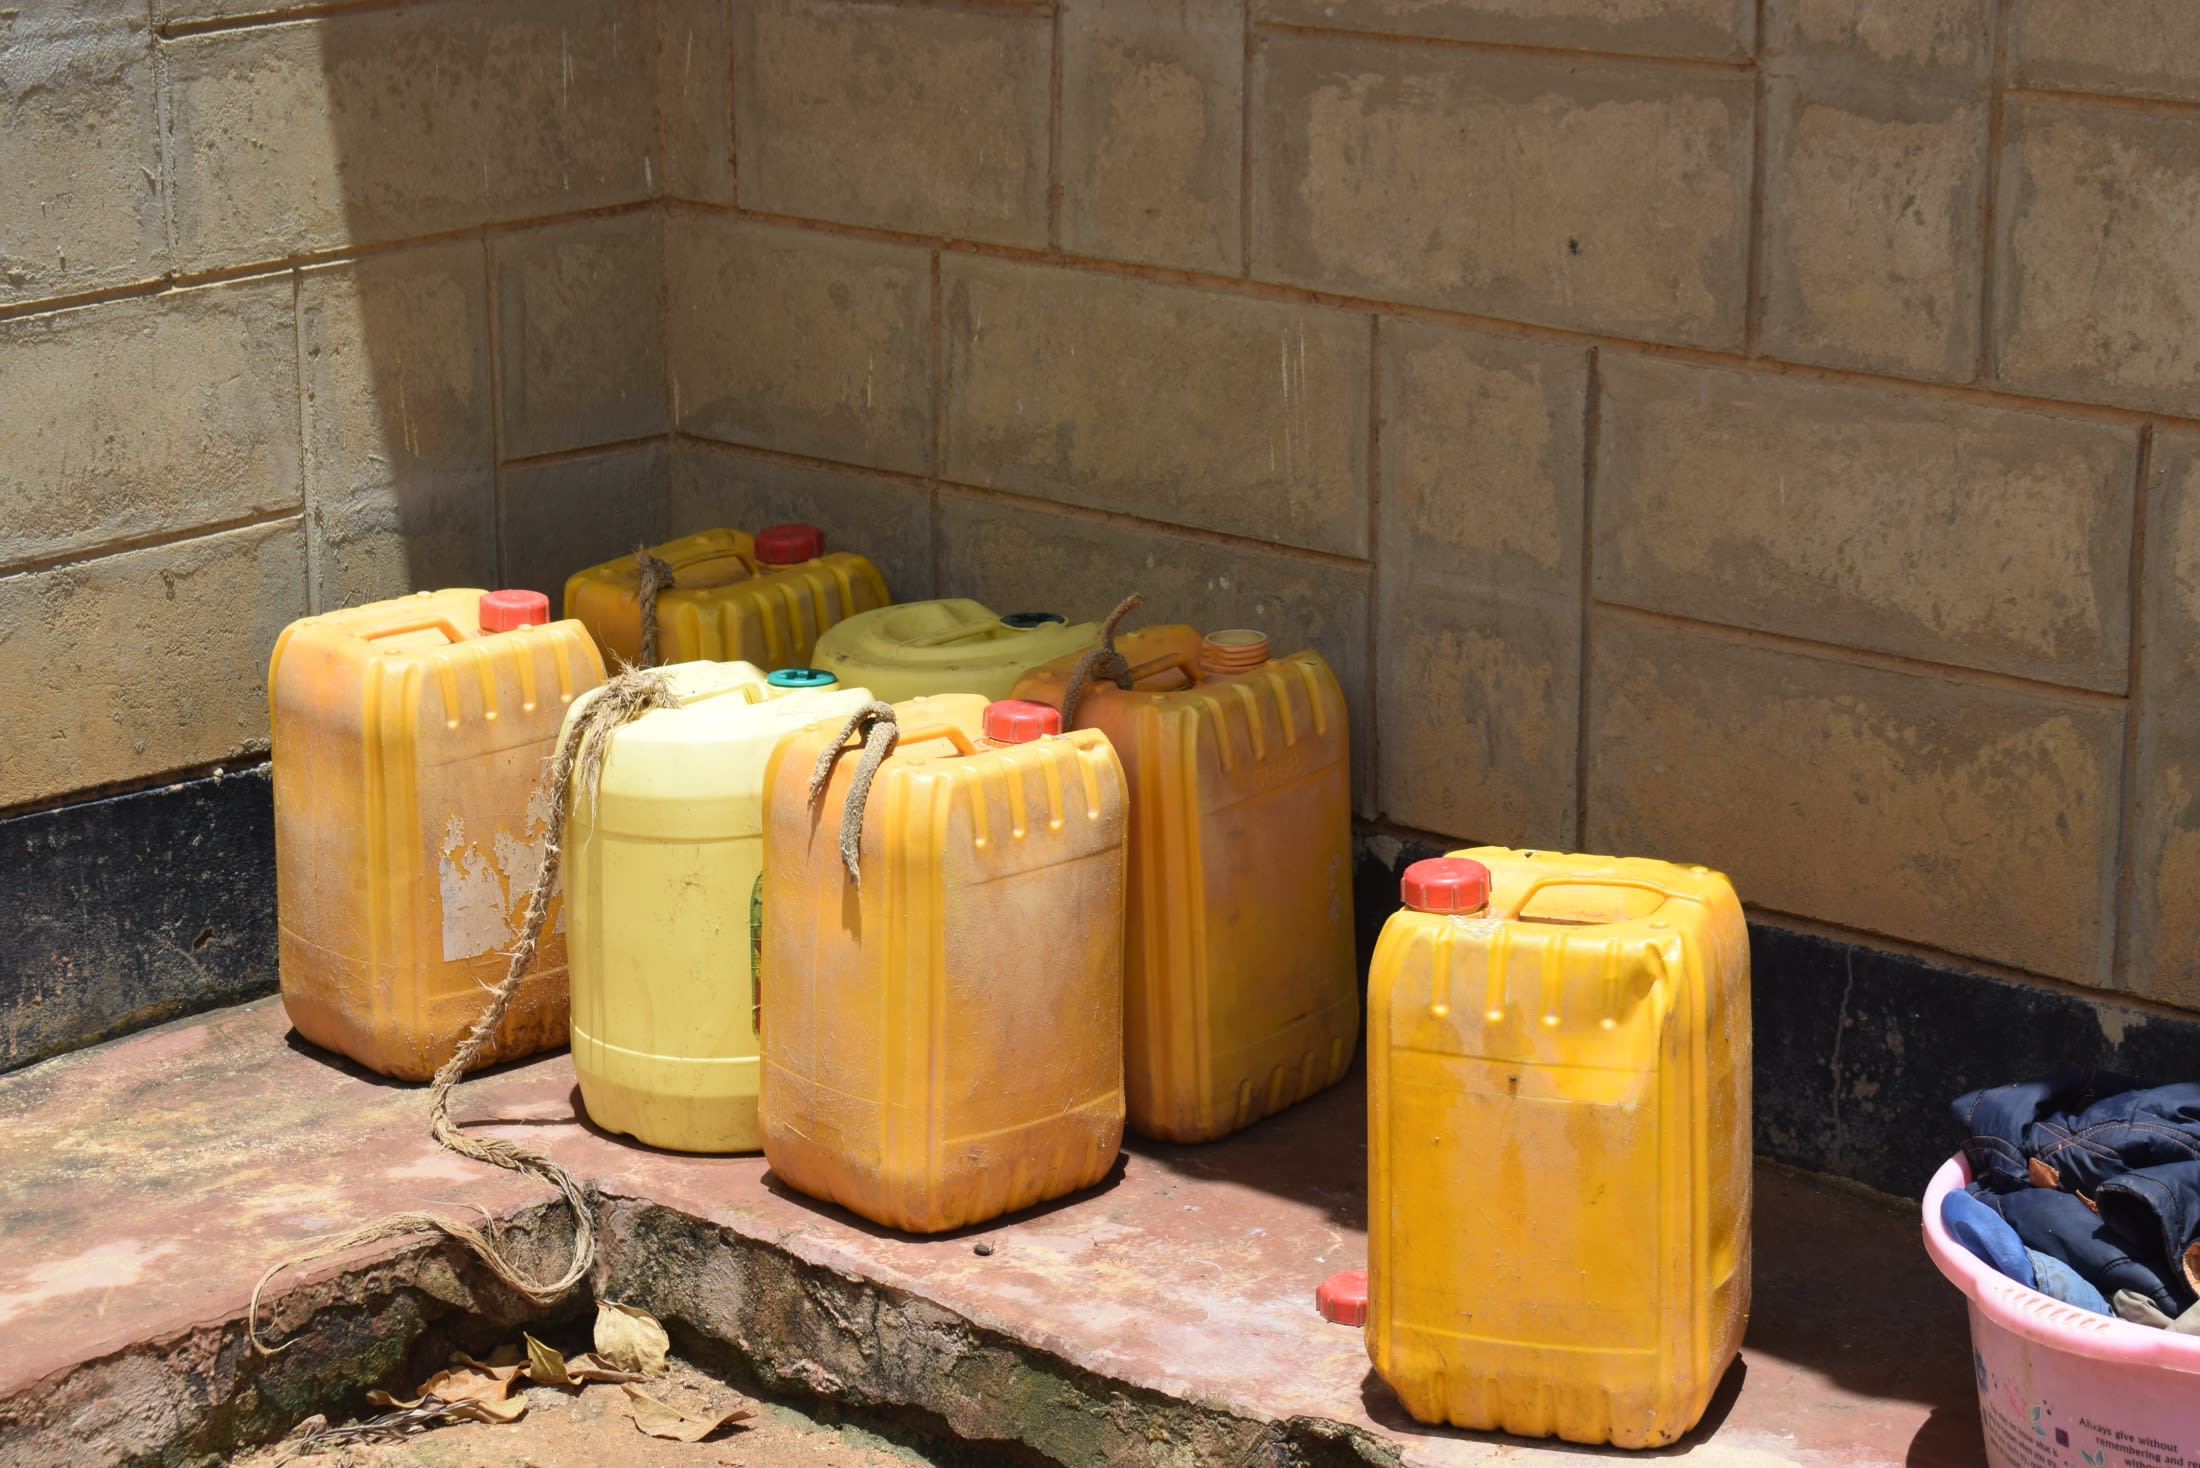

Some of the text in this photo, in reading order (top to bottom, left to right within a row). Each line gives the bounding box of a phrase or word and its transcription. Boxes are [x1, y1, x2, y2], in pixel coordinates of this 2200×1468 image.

[2079, 1417, 2178, 1453] Always give without
[2096, 1437, 2161, 1463] remembering
[2164, 1456, 2184, 1467] and
